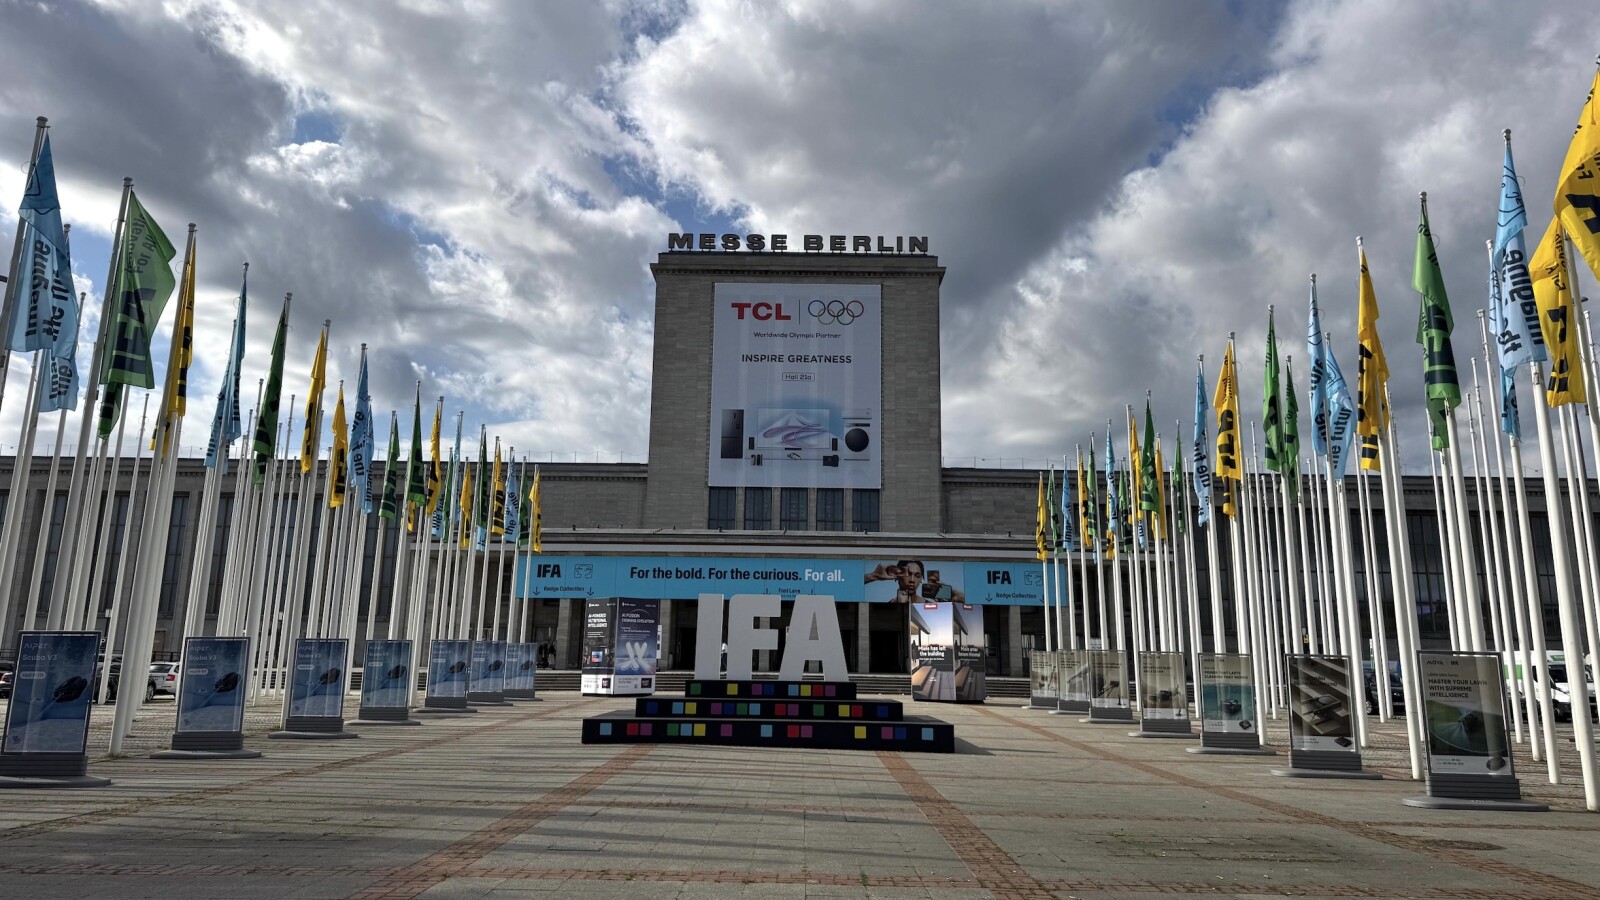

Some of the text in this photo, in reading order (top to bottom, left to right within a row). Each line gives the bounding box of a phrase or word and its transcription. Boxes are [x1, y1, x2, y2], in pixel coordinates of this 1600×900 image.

[668, 233, 929, 253] MESSE BERLIN
[731, 302, 792, 321] TCL
[753, 331, 788, 339] Worldwide
[788, 332, 815, 340] Olympic
[741, 354, 852, 364] INSPIRE GREATNESS
[537, 563, 562, 578] IFA
[630, 566, 845, 582] For the bold. For the curious. For all.
[987, 570, 1012, 585] IFA
[694, 593, 849, 681] IFA
